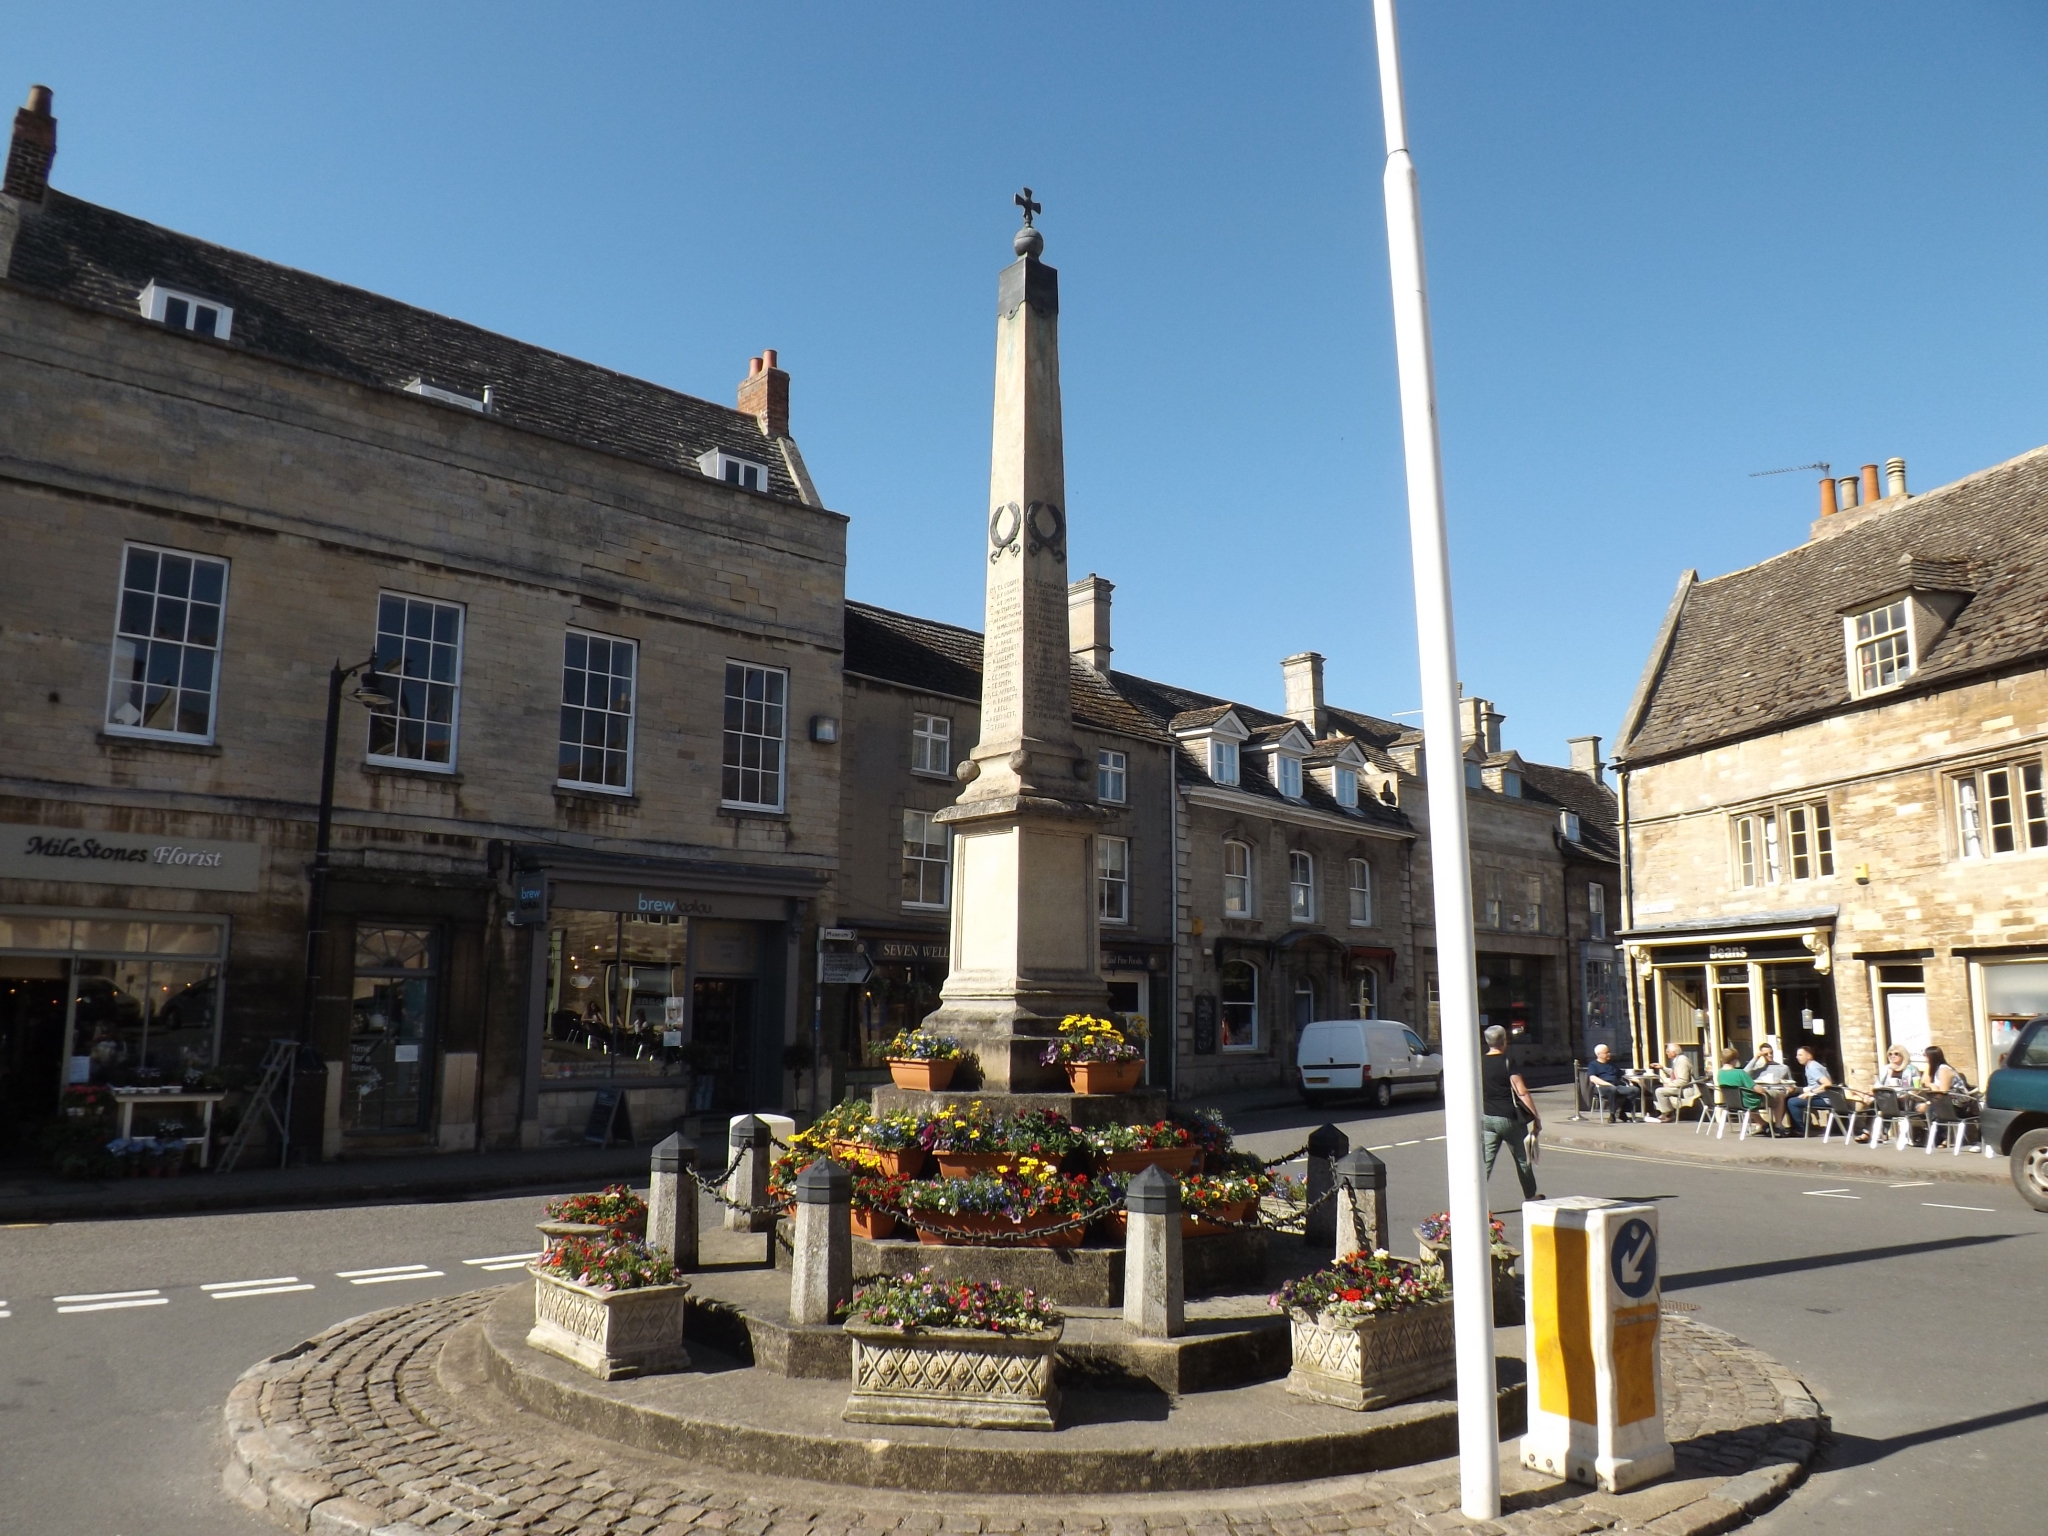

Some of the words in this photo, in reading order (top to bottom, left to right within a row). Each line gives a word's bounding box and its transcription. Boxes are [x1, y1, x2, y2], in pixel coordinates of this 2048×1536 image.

[25, 836, 148, 863] MileStones
[153, 846, 222, 867] Florist
[521, 886, 541, 899] brew
[638, 892, 676, 912] brew
[883, 944, 919, 957] SEVEN
[1709, 945, 1748, 960] Beans
[1117, 956, 1128, 965] Fine
[351, 1063, 372, 1071] Brew
